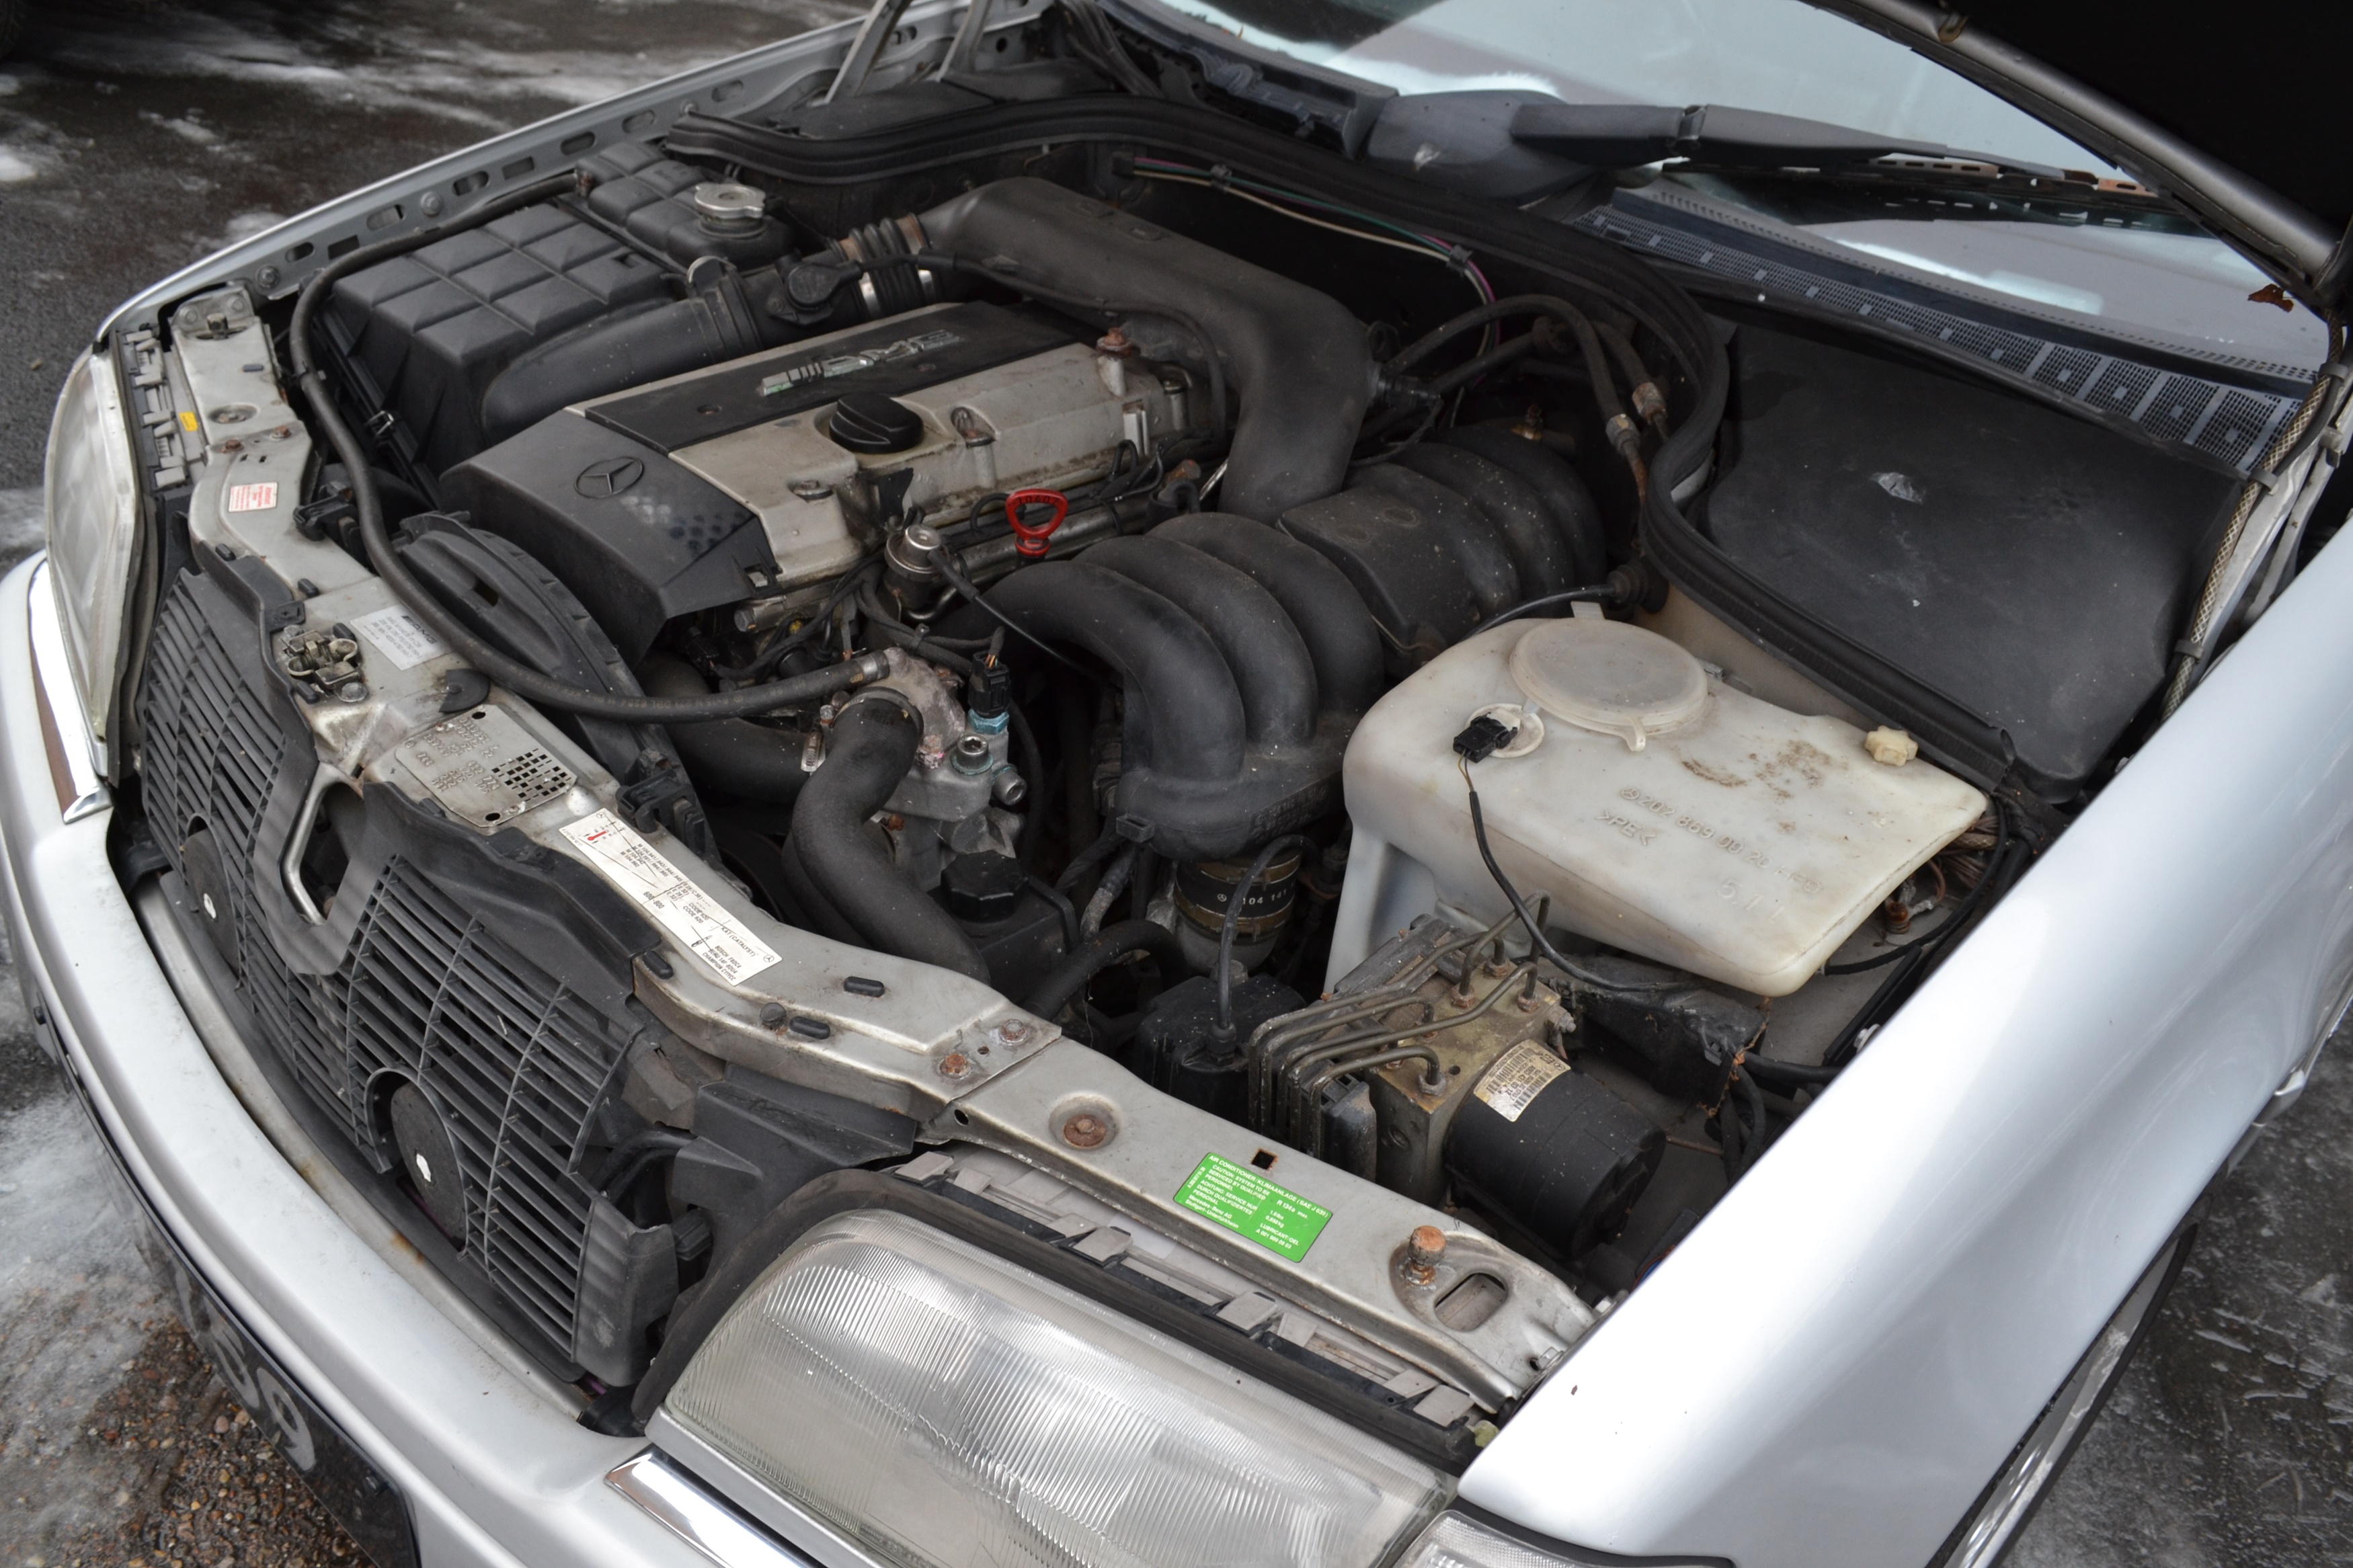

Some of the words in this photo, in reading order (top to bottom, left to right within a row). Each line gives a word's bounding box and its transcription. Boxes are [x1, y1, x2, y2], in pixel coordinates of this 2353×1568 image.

[410, 622, 438, 644] AMG
[1638, 794, 1674, 818] 202
[1677, 814, 1714, 839] 869
[1746, 850, 1771, 868] 20
[682, 905, 696, 917] CODE
[721, 925, 731, 935] KAT
[729, 934, 756, 956] (CATALYST)
[715, 945, 729, 957] BOSCH
[702, 952, 723, 969] CHAMPION
[1504, 1087, 1513, 1096] 12
[1205, 1173, 1232, 1190] PERSONNEL
[1208, 1169, 1232, 1183] SERVICED
[1240, 1185, 1265, 1200] QUALIFIED
[1212, 1164, 1234, 1178] CAUTION:
[1235, 1175, 1255, 1188] SYSTEM
[1193, 1189, 1218, 1204] PERSONAL
[1196, 1184, 1214, 1195] DURCH
[1213, 1193, 1252, 1214] QUALIFIZIERTES
[1225, 1192, 1246, 1204] SERVICE
[1296, 1199, 1312, 1208] (SAE
